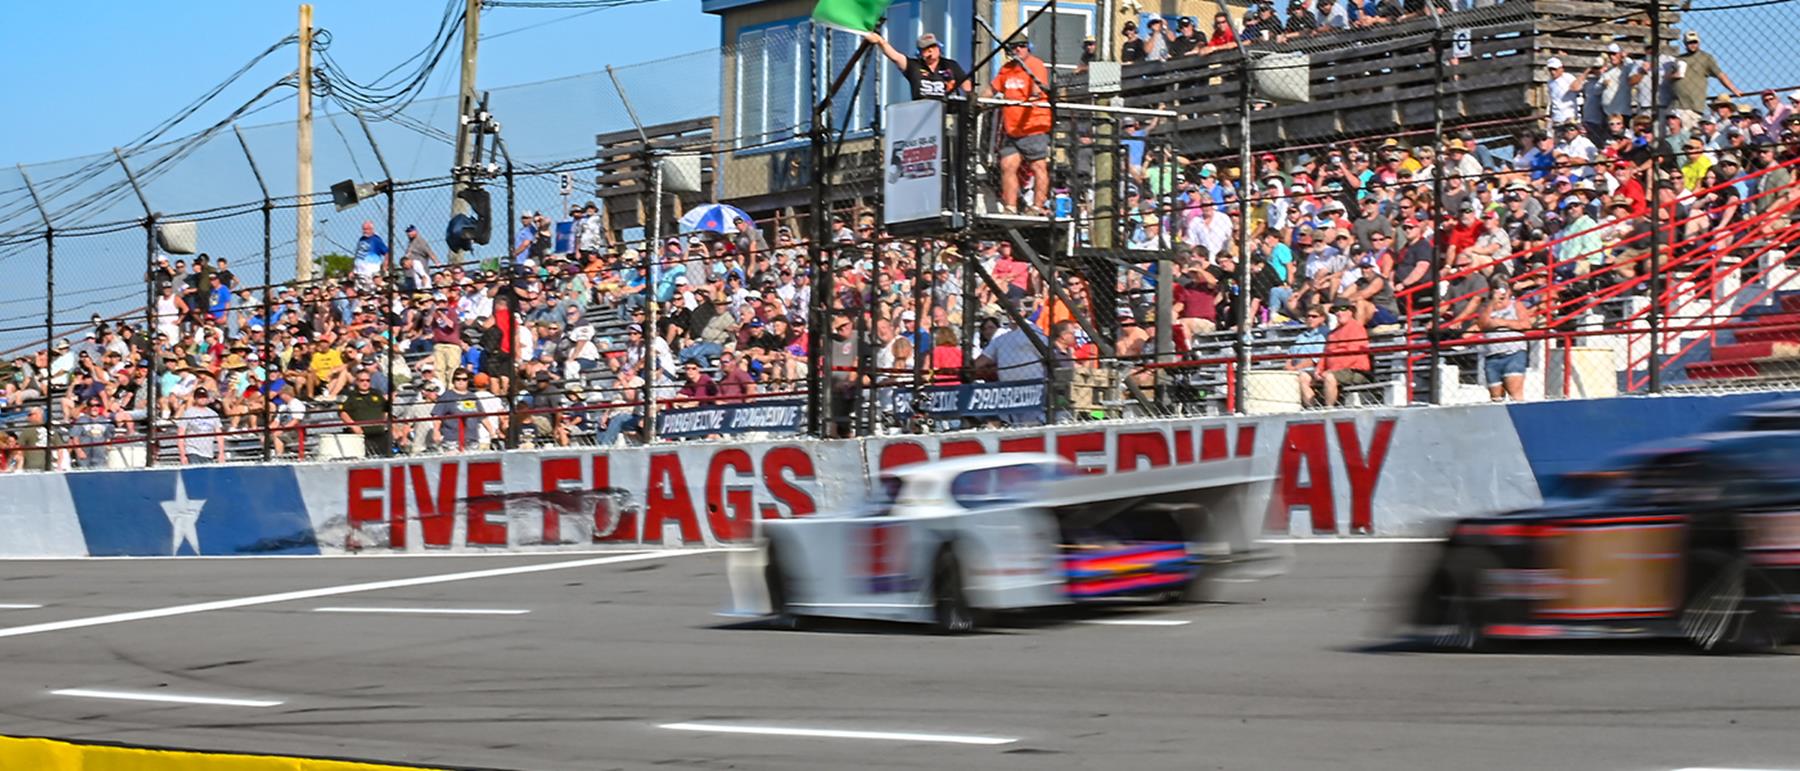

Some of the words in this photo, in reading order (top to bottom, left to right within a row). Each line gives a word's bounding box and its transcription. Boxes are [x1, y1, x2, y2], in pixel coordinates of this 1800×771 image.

[561, 174, 569, 189] B
[346, 460, 508, 550] FIVE
[540, 446, 816, 545] FLAGS
